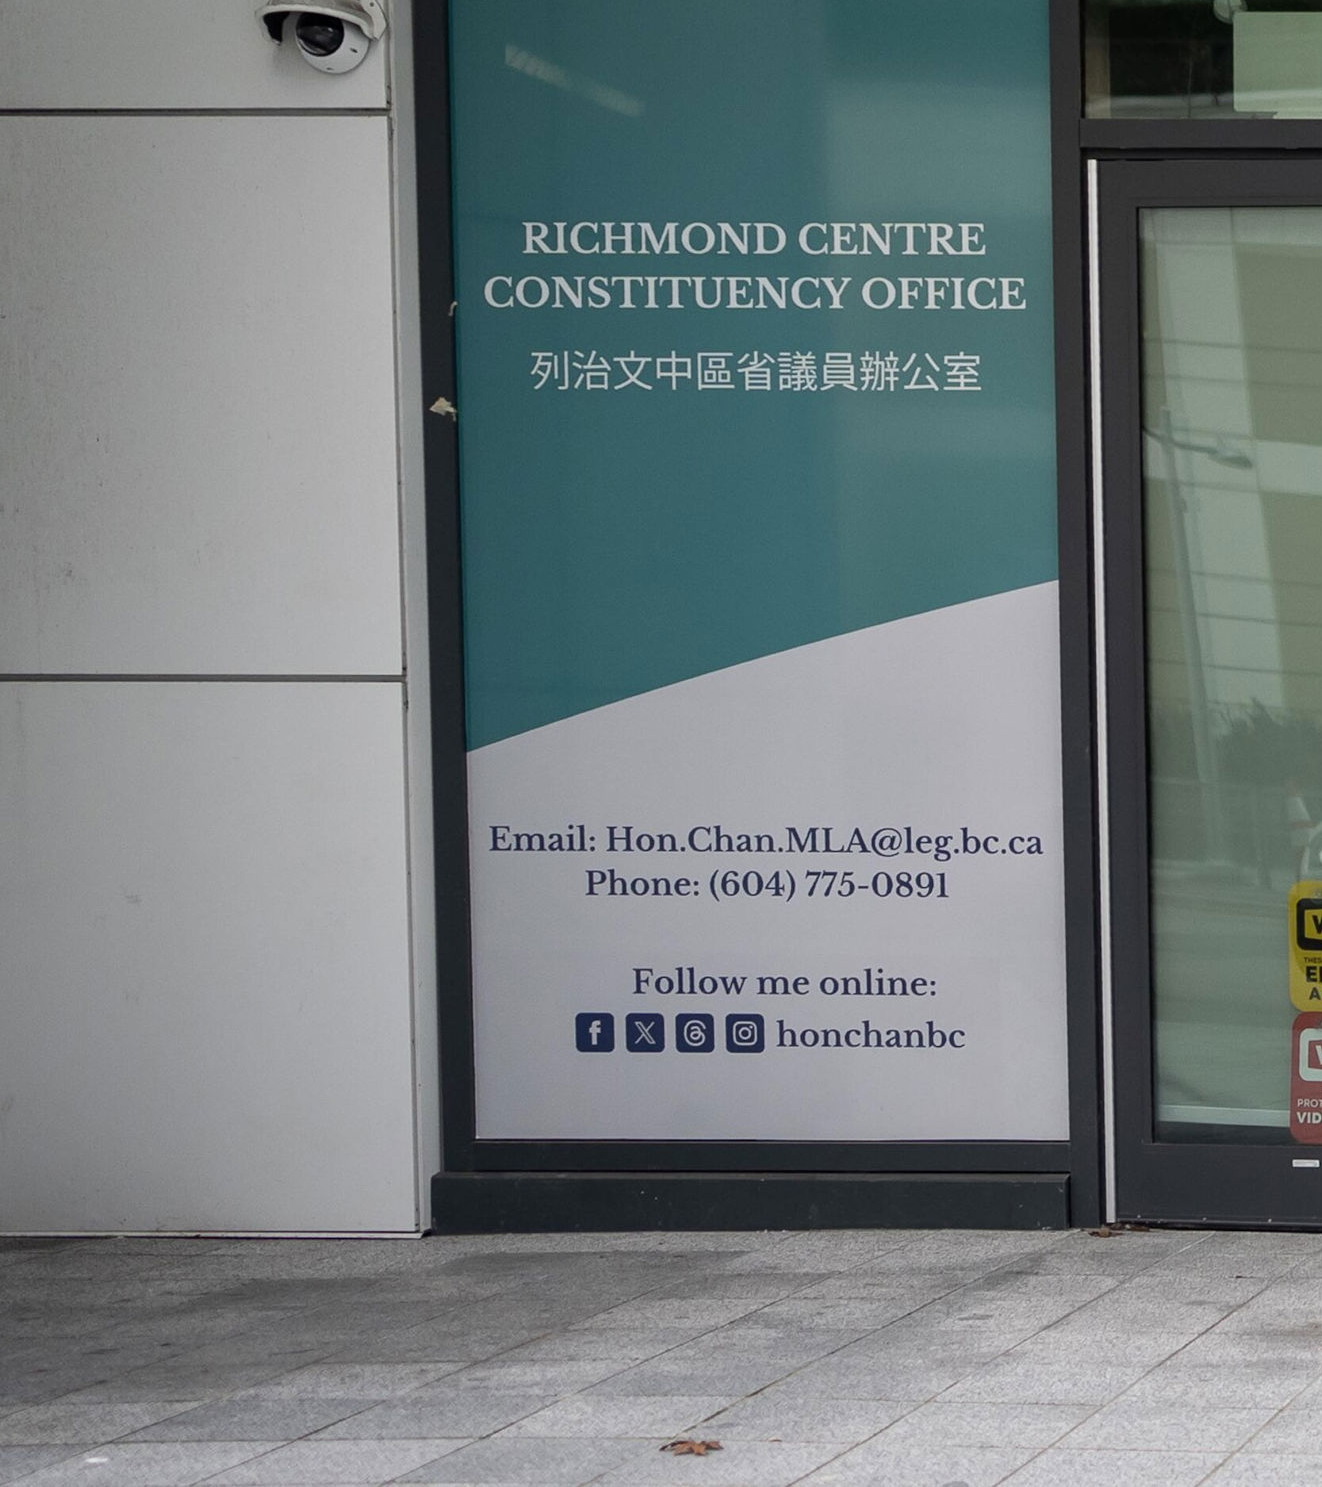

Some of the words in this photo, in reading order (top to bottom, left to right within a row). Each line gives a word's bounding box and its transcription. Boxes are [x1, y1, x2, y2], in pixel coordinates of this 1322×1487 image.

[523, 222, 786, 254] RICHMOND
[799, 223, 986, 255] CENTRE
[485, 276, 852, 309] CONSTITUENCY
[862, 277, 1026, 309] OFFICE
[531, 351, 981, 391] 列治文中區省議員辦公室
[489, 825, 595, 851] Email:
[606, 825, 1043, 861] Hon.Chan.MLA@leg.bc.ca
[586, 869, 699, 896] Phone:
[710, 870, 795, 902] (604)
[806, 870, 949, 897] 775-0891
[633, 967, 747, 994] Follow
[756, 977, 809, 995] me
[820, 968, 935, 996] online:
[776, 1020, 965, 1048] honchanbc
